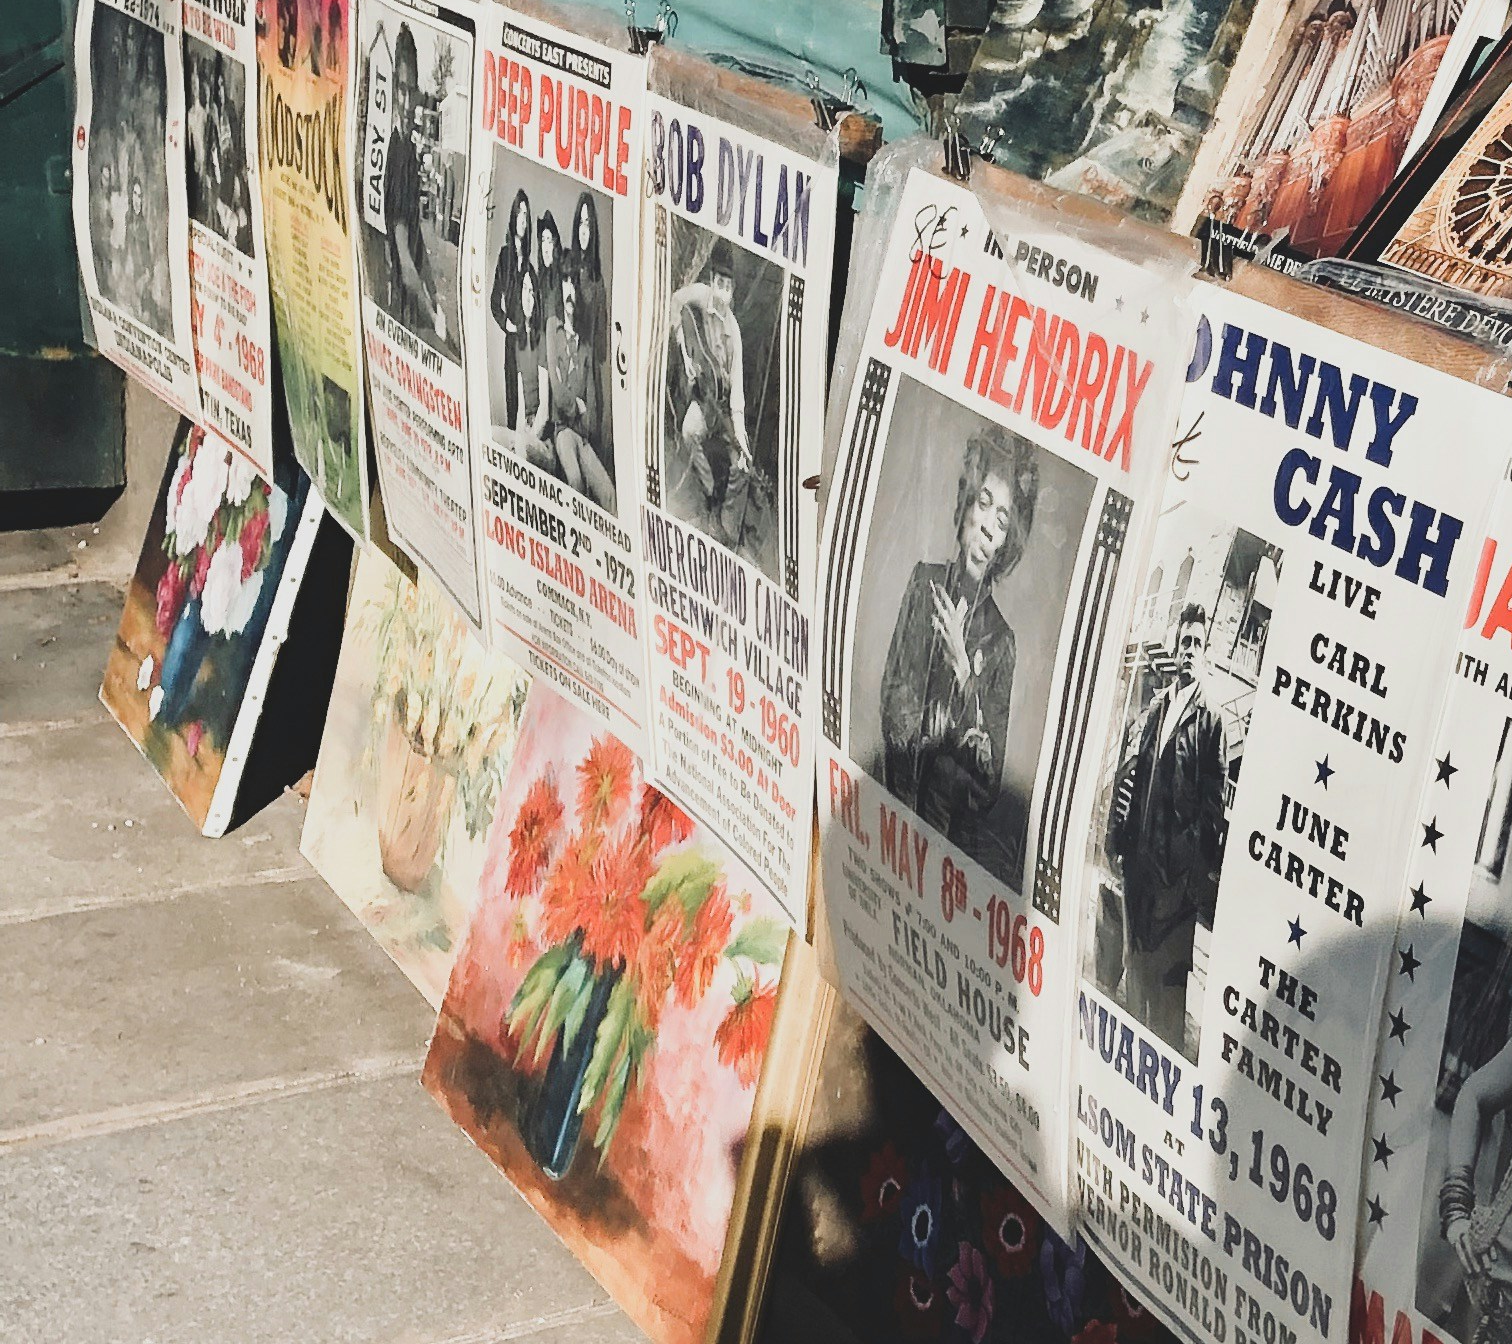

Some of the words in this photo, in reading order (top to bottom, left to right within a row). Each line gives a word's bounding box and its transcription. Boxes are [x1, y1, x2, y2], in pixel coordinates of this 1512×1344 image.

[503, 26, 541, 58] CONCERTS
[543, 41, 565, 67] EAST
[566, 51, 611, 86] PRESENTS
[482, 49, 533, 149] DEEP
[538, 74, 632, 197] PURPLE
[651, 110, 705, 214] BOB
[716, 136, 812, 268] DYLAN
[1015, 240, 1099, 304] PERSON
[234, 331, 265, 386] 1968
[395, 355, 462, 433] SPRINGSTEEN
[421, 343, 443, 377] WITH
[883, 250, 971, 375] JIMI
[963, 284, 1155, 474] HENDRIX
[225, 405, 252, 448] TEXAS
[483, 474, 567, 550] SEPTEMBER
[572, 496, 632, 553] SILVERHEAD
[1273, 447, 1465, 599] CASH
[484, 508, 526, 560] LONG
[528, 536, 586, 598] ISLAND
[589, 576, 638, 640] ARENA
[640, 504, 747, 626] UNDERGROUND
[755, 578, 809, 681] CAVERN
[648, 572, 738, 661] GREENWICH
[743, 636, 803, 716] VILLAGE
[654, 614, 716, 693] SEPT.
[759, 694, 801, 768] 1960
[660, 689, 718, 746] Admission
[720, 733, 754, 778] $3.00
[771, 780, 797, 822] Door
[672, 669, 722, 722] BEGINNING
[742, 726, 784, 778] MIDNIGHT
[1271, 665, 1407, 765] PERKINS
[666, 764, 721, 823] Advancement
[732, 824, 763, 867] Colored
[763, 861, 789, 897] People
[680, 752, 714, 793] National
[716, 785, 767, 843] Association
[1276, 793, 1350, 861] JUNE
[879, 802, 928, 899] MAY
[986, 894, 1055, 997] 1968
[892, 909, 947, 991] FIELD
[957, 969, 1031, 1072] HOUSE
[1221, 1031, 1334, 1137] FAMILY
[1119, 1179, 1228, 1306] PERMISION
[1141, 1143, 1218, 1242] STATE
[1223, 1212, 1333, 1339] PRISON
[1149, 1247, 1227, 1344] RONALD
